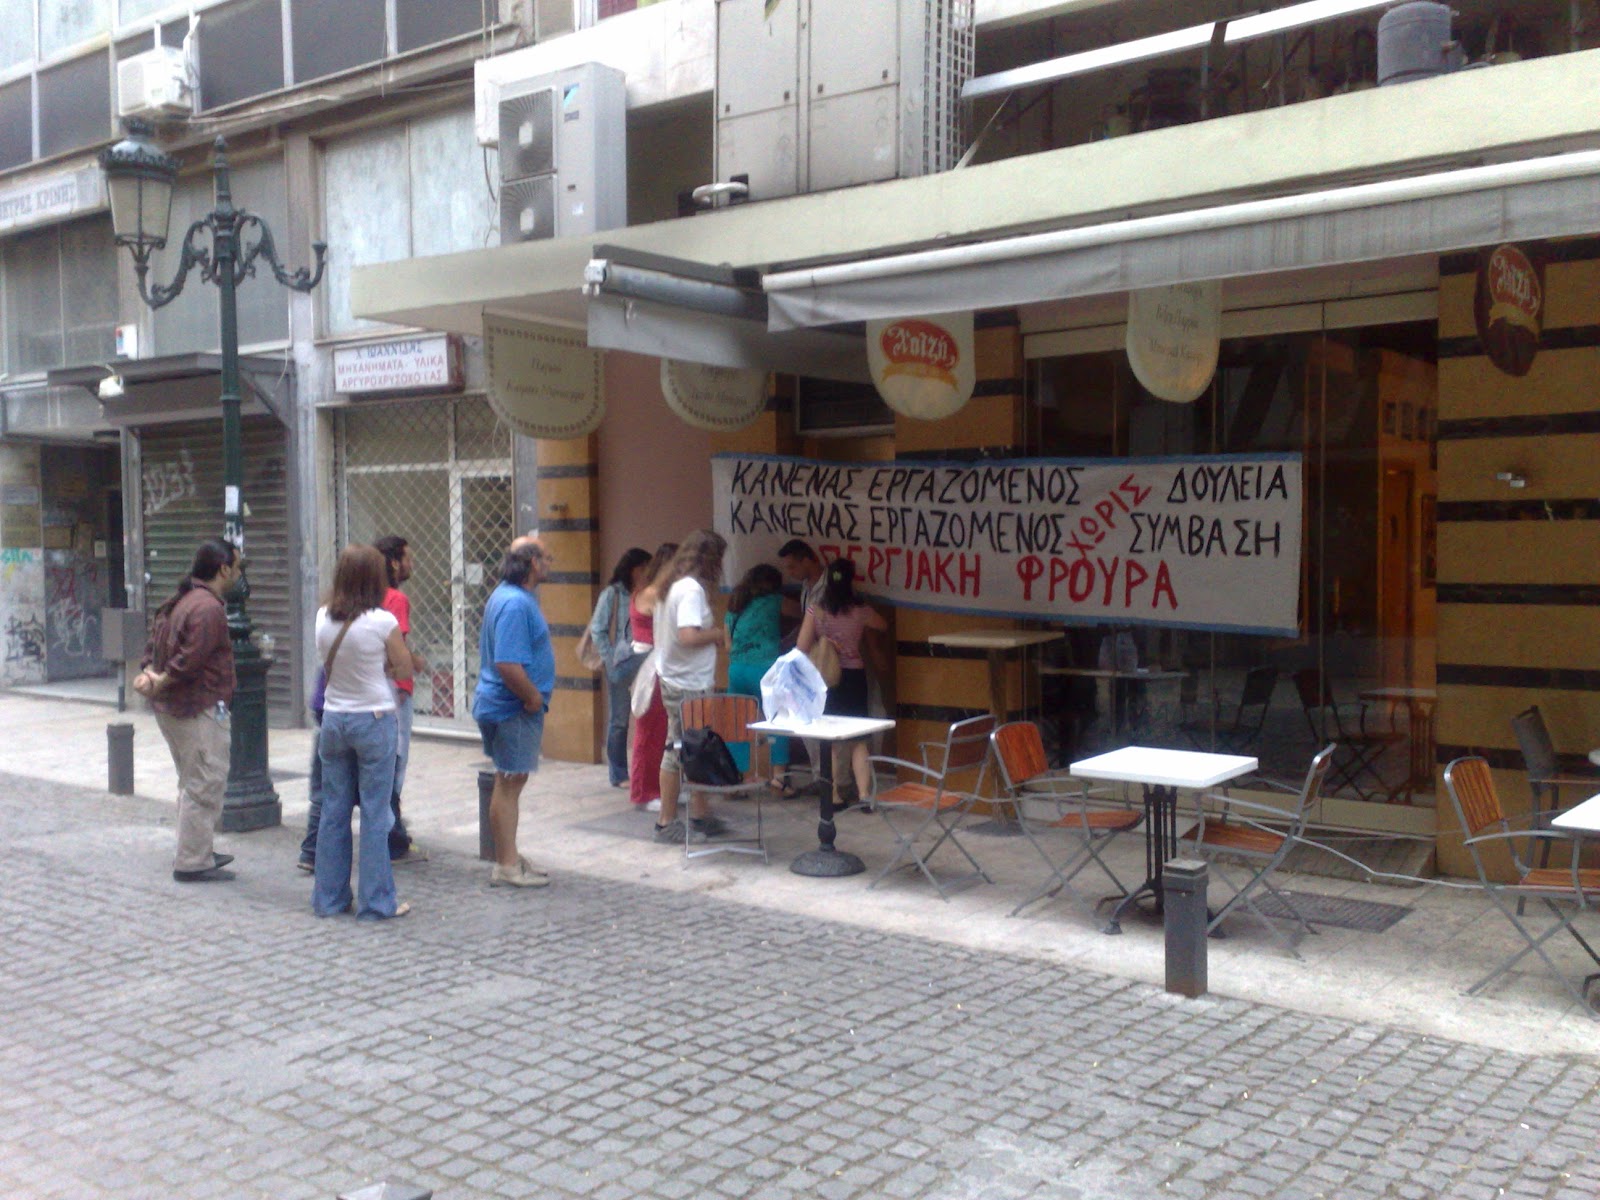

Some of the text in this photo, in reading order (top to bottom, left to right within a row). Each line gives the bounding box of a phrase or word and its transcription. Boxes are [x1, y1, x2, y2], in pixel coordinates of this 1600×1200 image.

[731, 460, 1085, 505] ΚΑΝΕΝΑΣ ΕΡΓΑΖΟΜΕΝΟΣ
[1167, 464, 1288, 503] ΔΟΥΛΕΙΑ
[730, 500, 1065, 555] ΚΑΝΕΝΑΣ ΕΡΓΑΖΟΜΕΝΟΣ
[1129, 512, 1281, 558] ΣΥΜΒΑΣΗ
[817, 545, 1178, 609] ΠΕΡΓΙΑΚΗ ΦΡΟΥΡΑ
